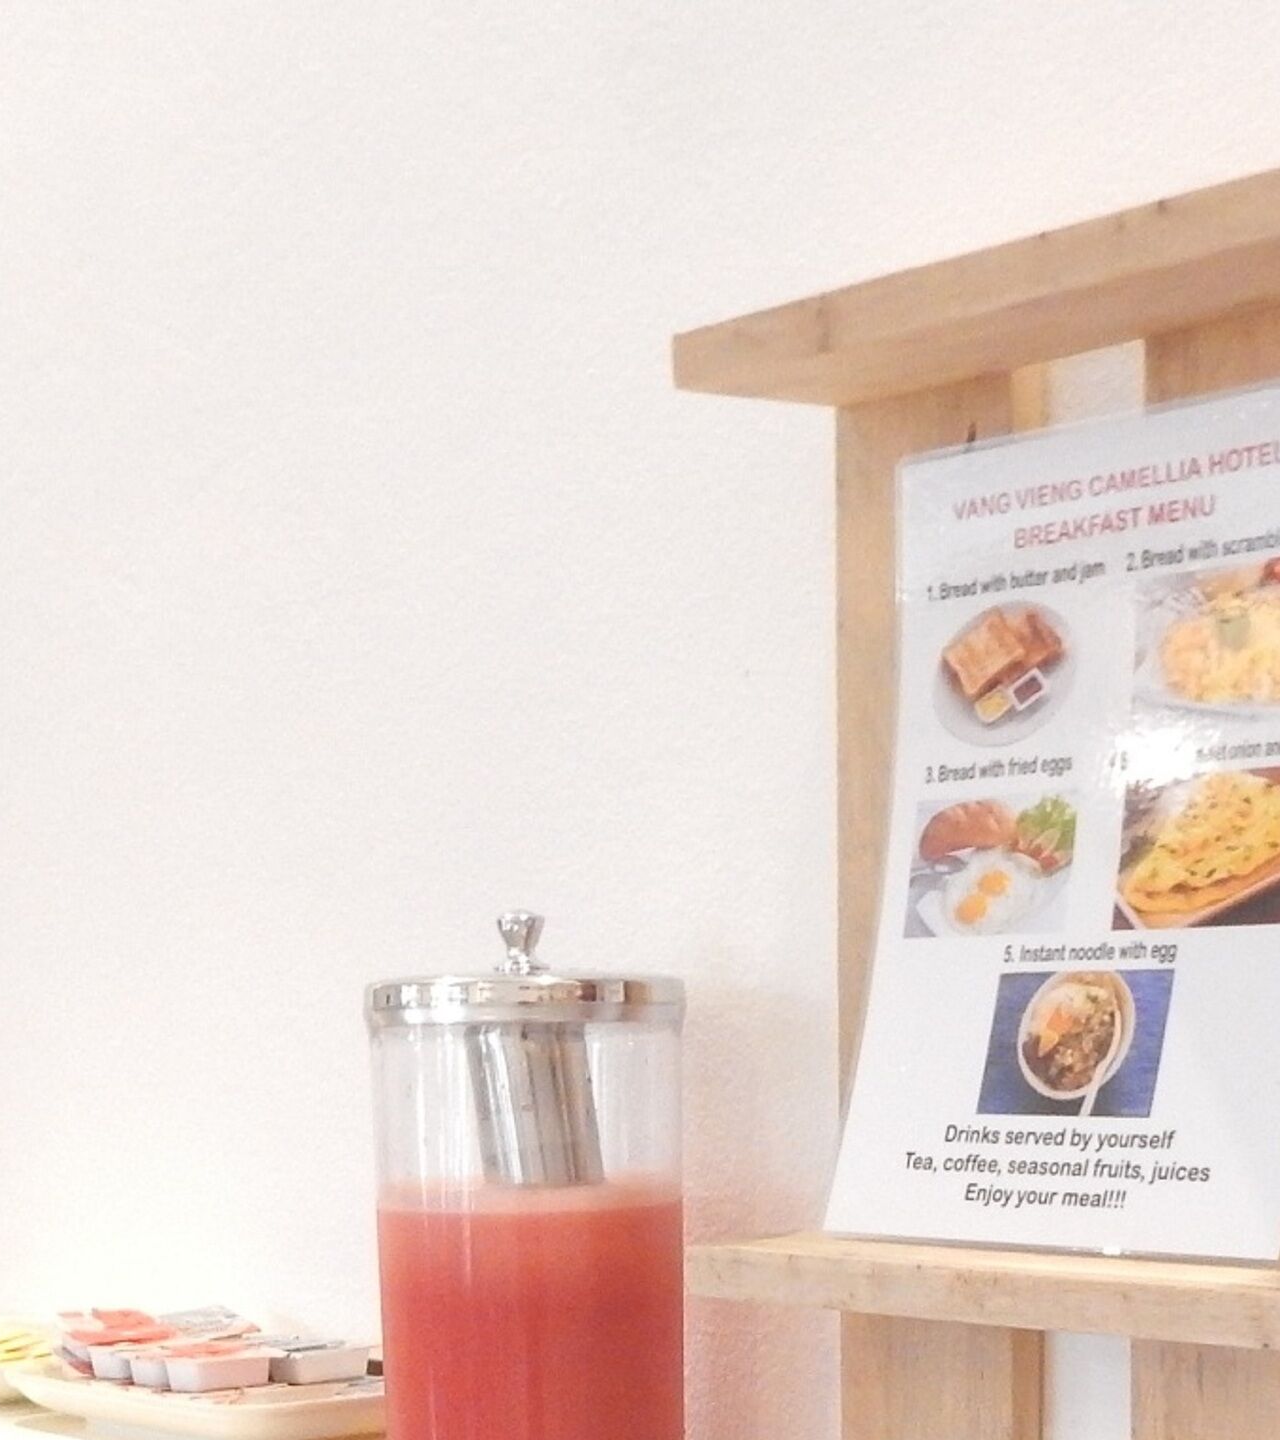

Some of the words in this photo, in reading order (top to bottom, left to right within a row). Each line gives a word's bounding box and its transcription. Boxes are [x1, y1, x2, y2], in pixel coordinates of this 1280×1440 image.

[953, 491, 1011, 520] VANG
[1015, 479, 1083, 510] VIENG
[1088, 456, 1202, 497] CAMELLIA
[1013, 506, 1142, 549] BREAKFAST
[1147, 493, 1217, 526] MENU
[1126, 551, 1139, 572] 2.
[1141, 543, 1185, 568] Bread
[1187, 538, 1219, 560] with
[940, 581, 978, 600] Bread
[980, 574, 1007, 594] with
[1010, 570, 1048, 589] butter
[1052, 562, 1077, 583] and
[1078, 562, 1106, 584] jam
[938, 762, 976, 783] Bread
[979, 758, 1005, 779] with
[1008, 755, 1038, 776] fried
[1040, 756, 1073, 777] eggs
[1003, 944, 1015, 963] 5.
[1019, 944, 1066, 963] Instant
[1068, 942, 1116, 961] noodle
[1119, 941, 1148, 960] with
[1150, 944, 1177, 964] egg
[944, 1124, 1001, 1145] Drinks
[1004, 1128, 1066, 1147] served
[1070, 1128, 1092, 1151] by
[1096, 1129, 1177, 1151] yourself
[905, 1152, 938, 1174] Tea,
[942, 1153, 1003, 1177] coffee,
[1007, 1158, 1090, 1178] seasonal
[1092, 1158, 1147, 1182] fruits,
[1147, 1161, 1212, 1185] juices
[964, 1182, 1012, 1208] Enjoy
[1014, 1188, 1057, 1209] your
[1061, 1189, 1128, 1210] meal!!!
